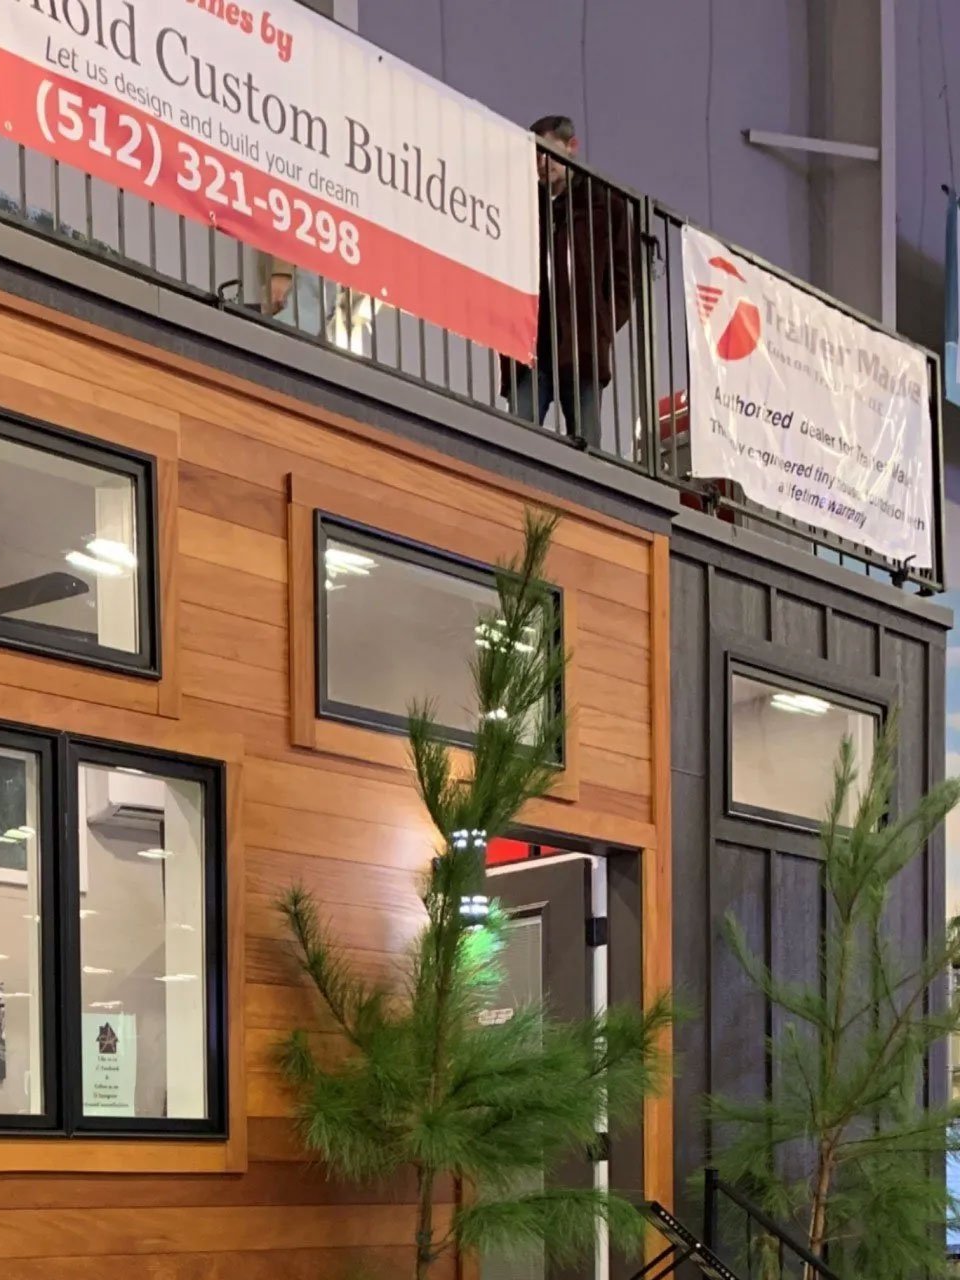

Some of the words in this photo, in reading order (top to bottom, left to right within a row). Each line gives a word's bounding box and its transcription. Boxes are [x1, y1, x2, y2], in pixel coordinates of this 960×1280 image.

[185, 0, 253, 33] mes
[260, 11, 293, 63] by
[36, 79, 162, 187] (512)
[176, 141, 361, 266] 321-9298
[45, 35, 79, 73] Let
[86, 59, 108, 86] us
[115, 72, 173, 120] design
[180, 108, 212, 140] and
[219, 121, 260, 164] build
[265, 150, 302, 182] your
[309, 168, 360, 209] dream
[156, 27, 330, 158] Custom
[345, 116, 501, 240] Builders
[786, 482, 827, 510] fetime
